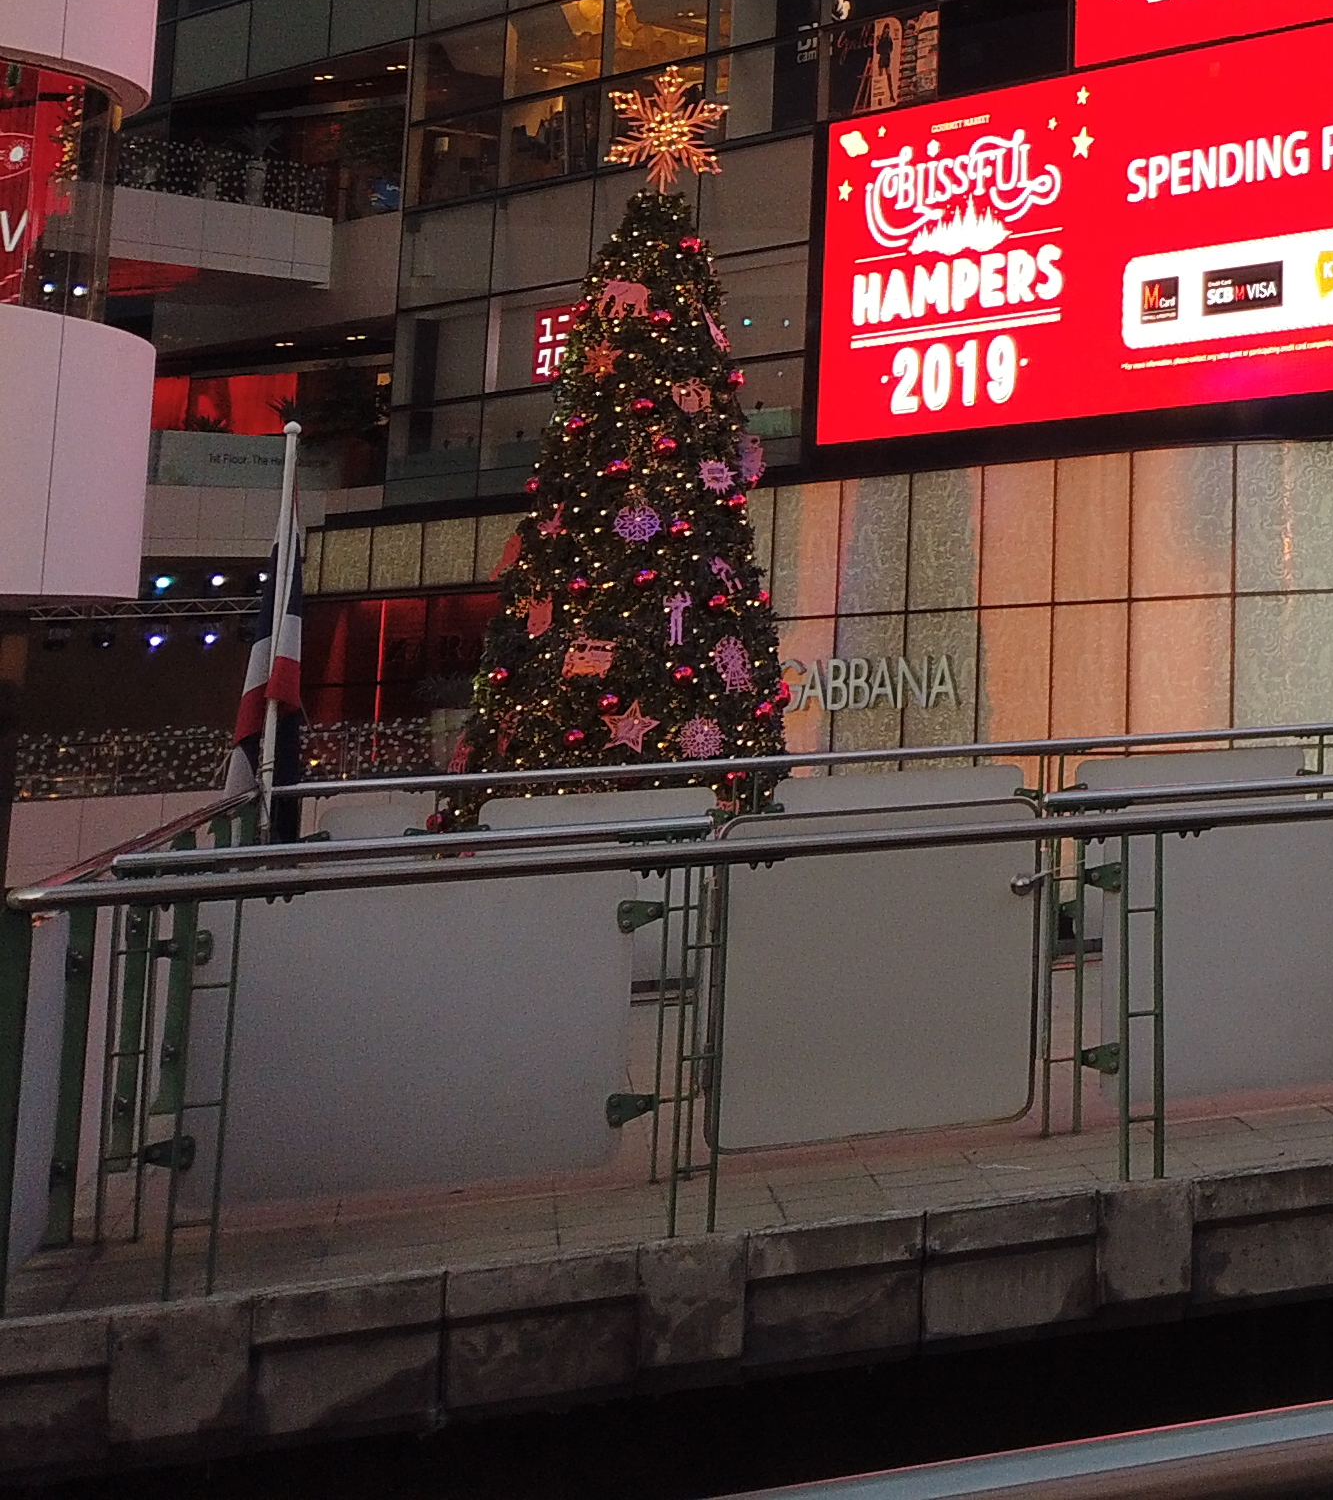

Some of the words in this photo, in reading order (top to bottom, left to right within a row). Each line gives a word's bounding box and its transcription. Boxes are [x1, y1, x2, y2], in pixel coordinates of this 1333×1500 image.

[1127, 130, 1310, 202] SPENDING
[852, 243, 1063, 326] HAMPERS
[1206, 286, 1234, 306] SCB
[1246, 280, 1278, 301] VISA
[889, 335, 1018, 414] 2019
[781, 654, 961, 713] GABBANA
